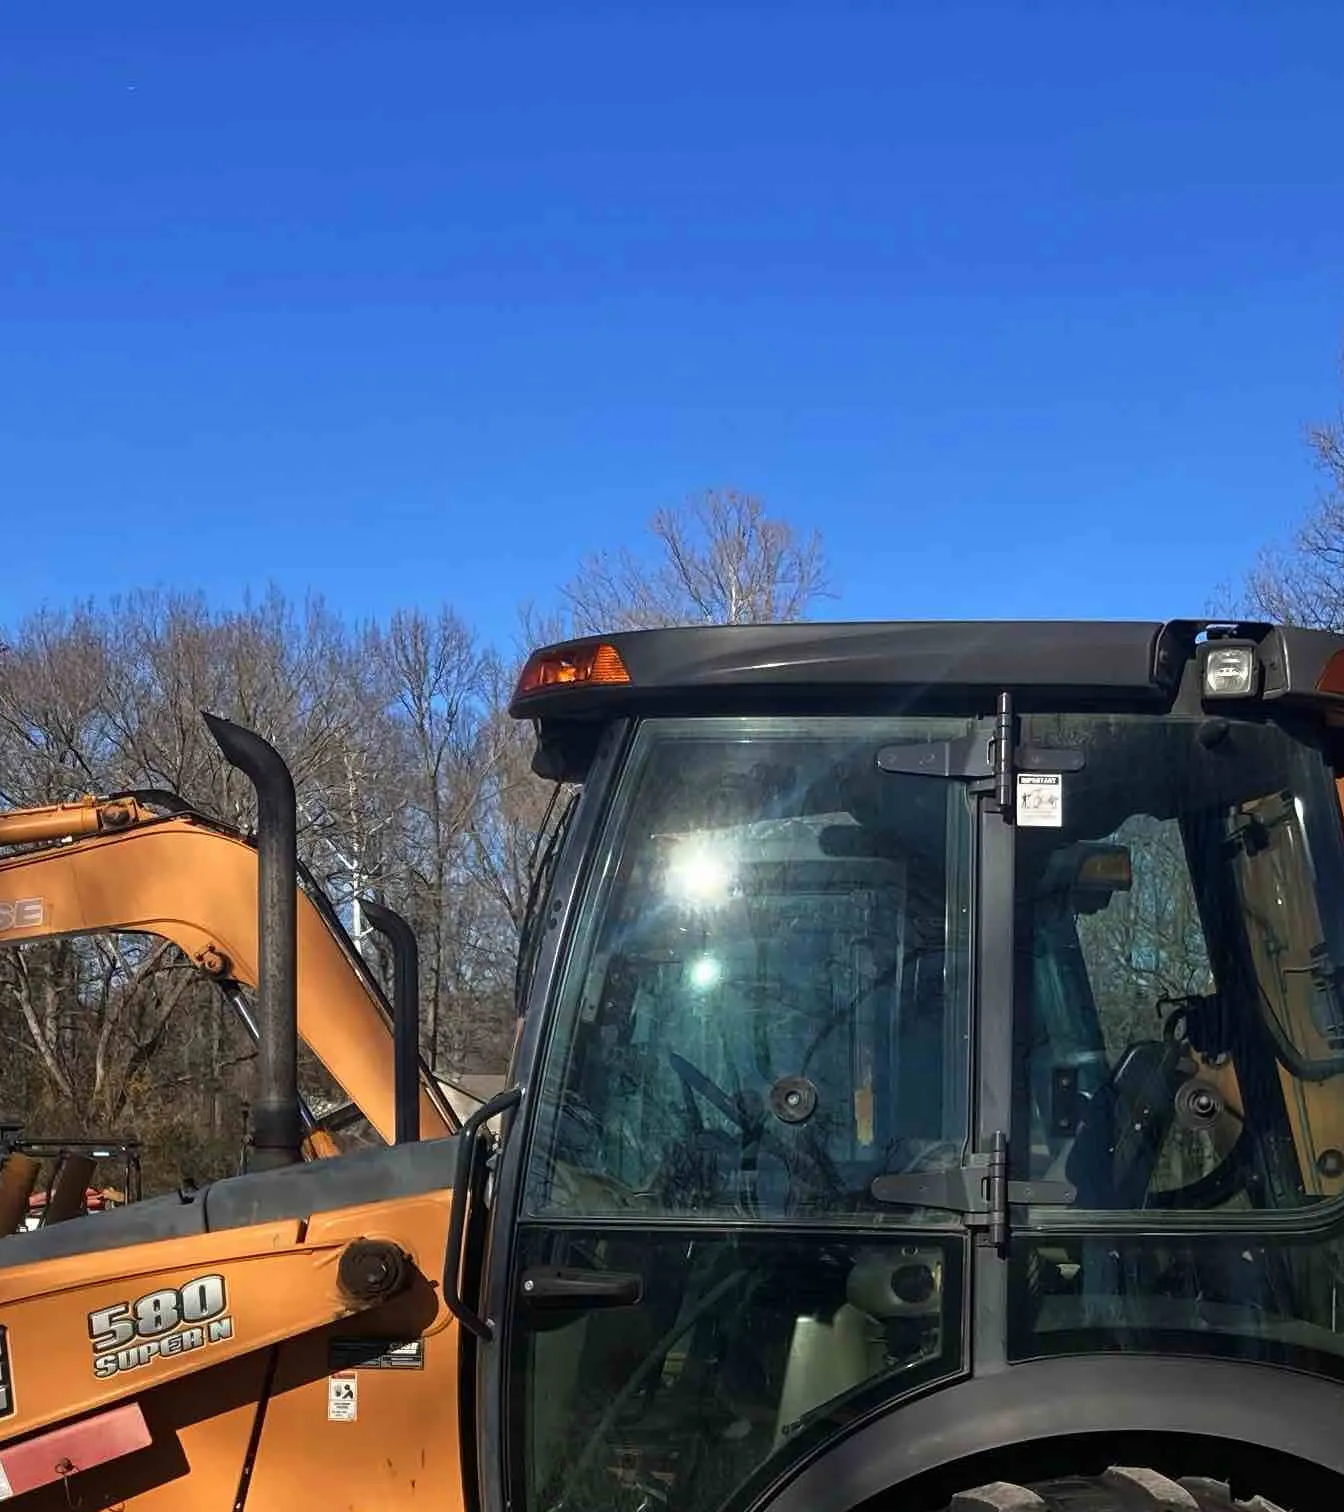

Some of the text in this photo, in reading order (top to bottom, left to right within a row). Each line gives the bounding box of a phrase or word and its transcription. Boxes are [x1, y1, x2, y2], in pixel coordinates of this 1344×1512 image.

[88, 1275, 225, 1353] 580
[94, 1316, 233, 1377] SUPER N
